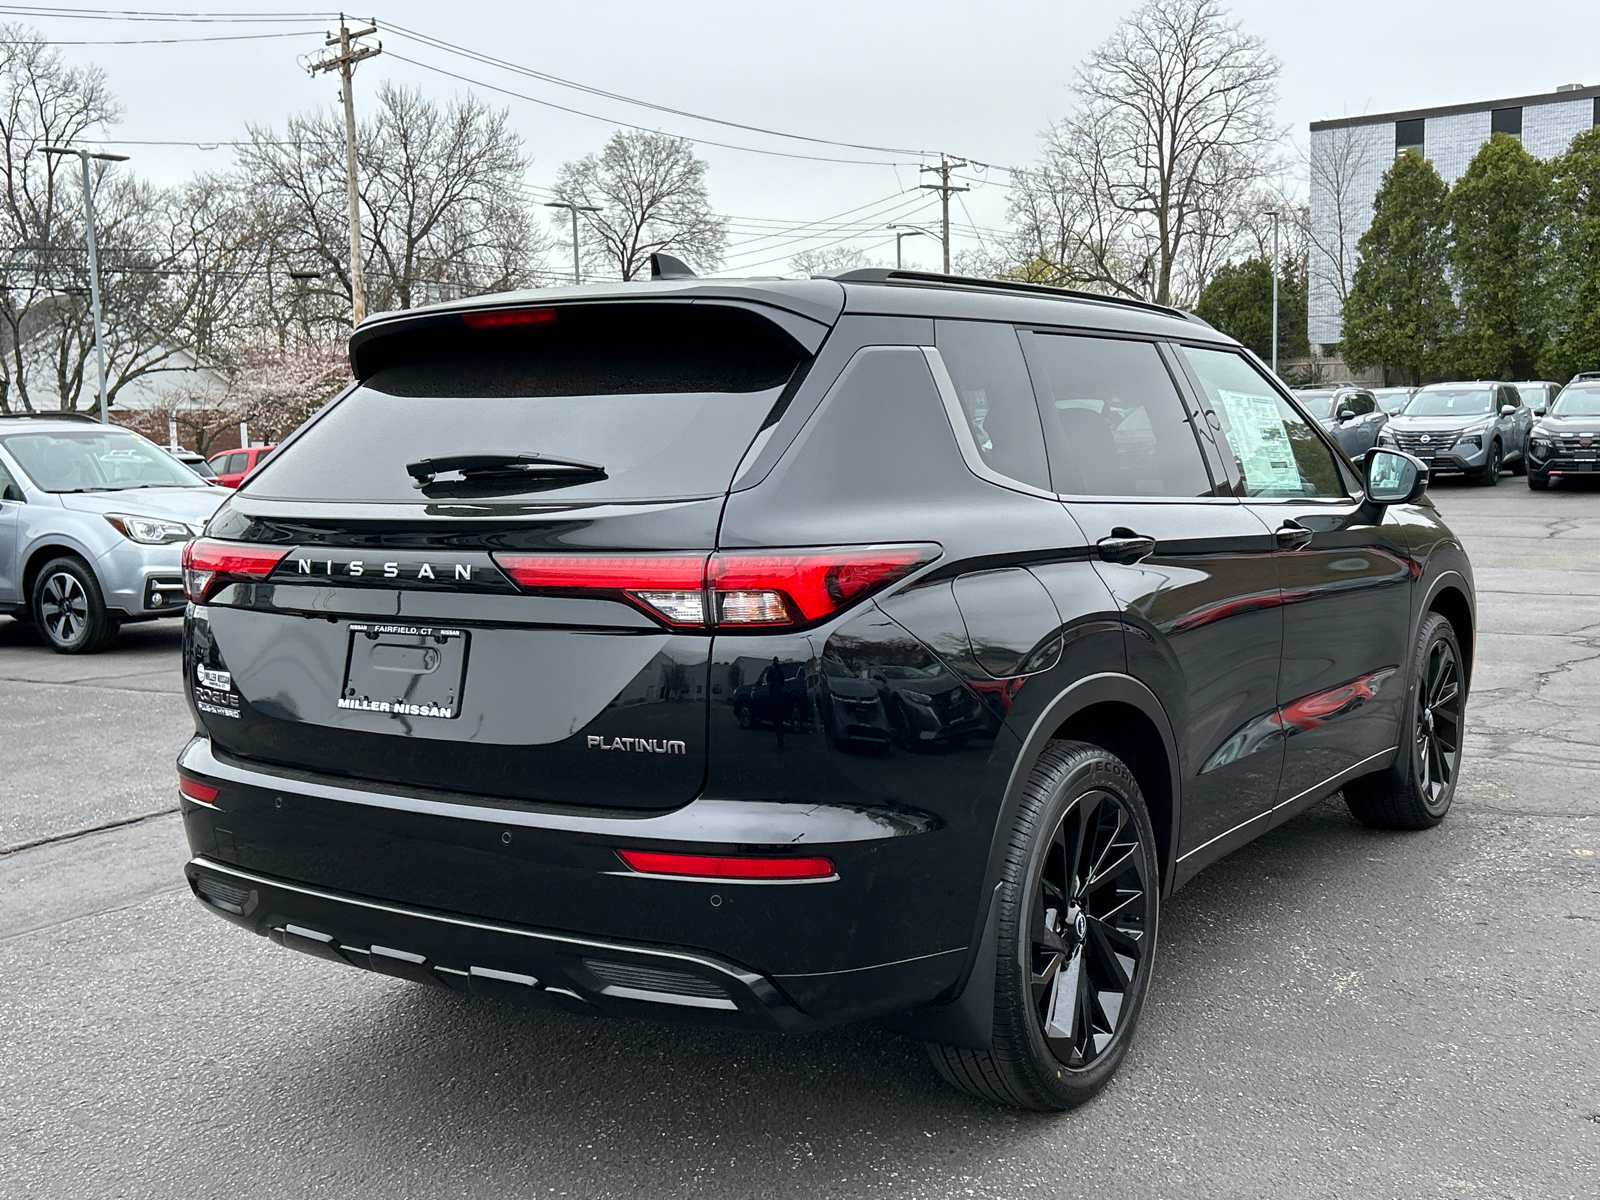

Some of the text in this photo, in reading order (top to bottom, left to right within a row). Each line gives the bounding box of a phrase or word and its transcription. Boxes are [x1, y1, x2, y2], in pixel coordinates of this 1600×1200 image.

[298, 558, 472, 581] NISSAN
[374, 625, 419, 635] FAIRFIELD,
[420, 627, 433, 635] CT
[196, 687, 239, 707] ROGUE
[338, 698, 452, 718] MILLER NISSAN
[587, 735, 686, 755] PLATINUM
